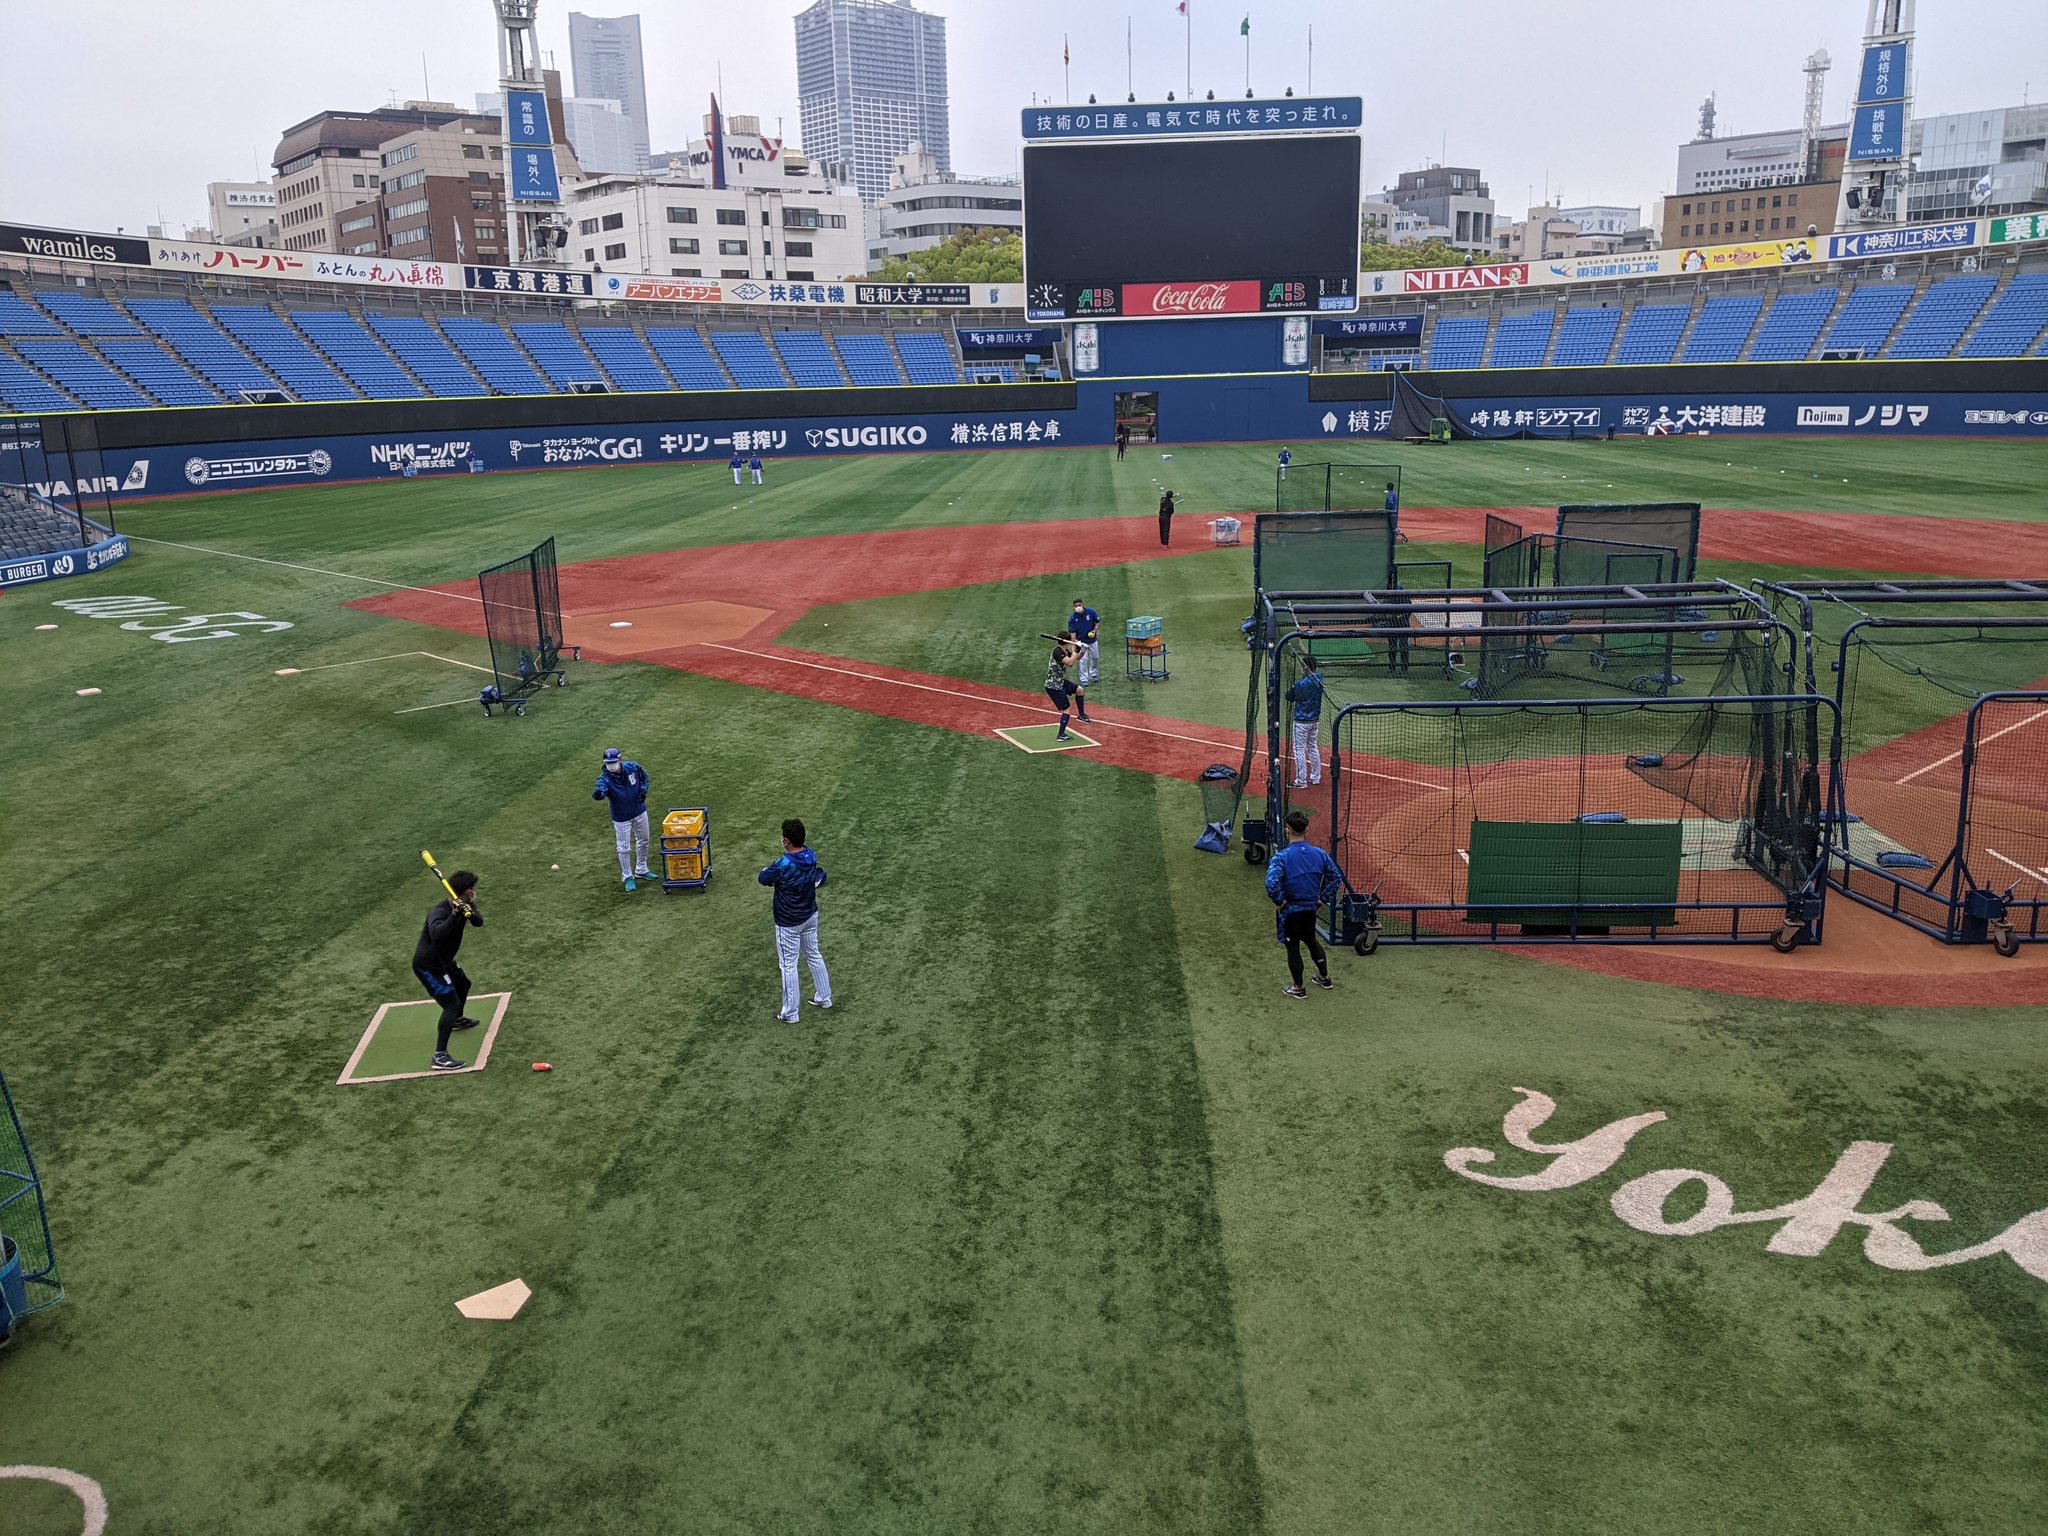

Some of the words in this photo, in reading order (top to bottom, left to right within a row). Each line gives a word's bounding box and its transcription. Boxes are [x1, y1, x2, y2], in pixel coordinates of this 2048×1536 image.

[1036, 105, 1350, 132] 技術の日産。電気で時代を突っ走れ。
[1871, 108, 1886, 145] 挑戦を
[688, 150, 710, 167] YMCA
[727, 146, 765, 161] YMCA
[1857, 147, 1894, 156] NISSAN
[526, 153, 541, 185] 場外へ
[1863, 225, 1968, 250] 神奈川工科大学
[20, 236, 117, 262] wamiles
[158, 248, 201, 263] ありあけ
[1576, 261, 1659, 279] 東亜建設工業
[1406, 268, 1500, 291] NITTAN
[628, 284, 721, 299] アーバンエナジー
[769, 284, 845, 302] 扶桑電機
[859, 287, 923, 303] 昭和大学
[1152, 283, 1230, 312] Coca-Cola
[1358, 320, 1407, 333] 神奈川大学
[986, 333, 1033, 344] 神奈川大学
[1470, 409, 1535, 427] 崎陽軒
[1538, 410, 1599, 425] シウマイ
[1624, 408, 1649, 416] オセアン
[1624, 417, 1649, 425] グループ
[1676, 405, 1766, 427] 大洋建設
[1855, 404, 1929, 426] ノジマ
[1965, 410, 2029, 424] ヨコレイ
[825, 426, 928, 447] SUGIKO
[950, 419, 1062, 444] 横浜信用金庫
[543, 439, 571, 447] タカナシ
[571, 437, 600, 446] ヨーグルト
[543, 446, 600, 463] おなかへ
[599, 438, 643, 460] GG!
[659, 430, 787, 453] キリン一番搾り
[210, 459, 307, 476] ニコニコレンタカー
[76, 476, 119, 494] AIR
[7, 564, 43, 580] BURGER
